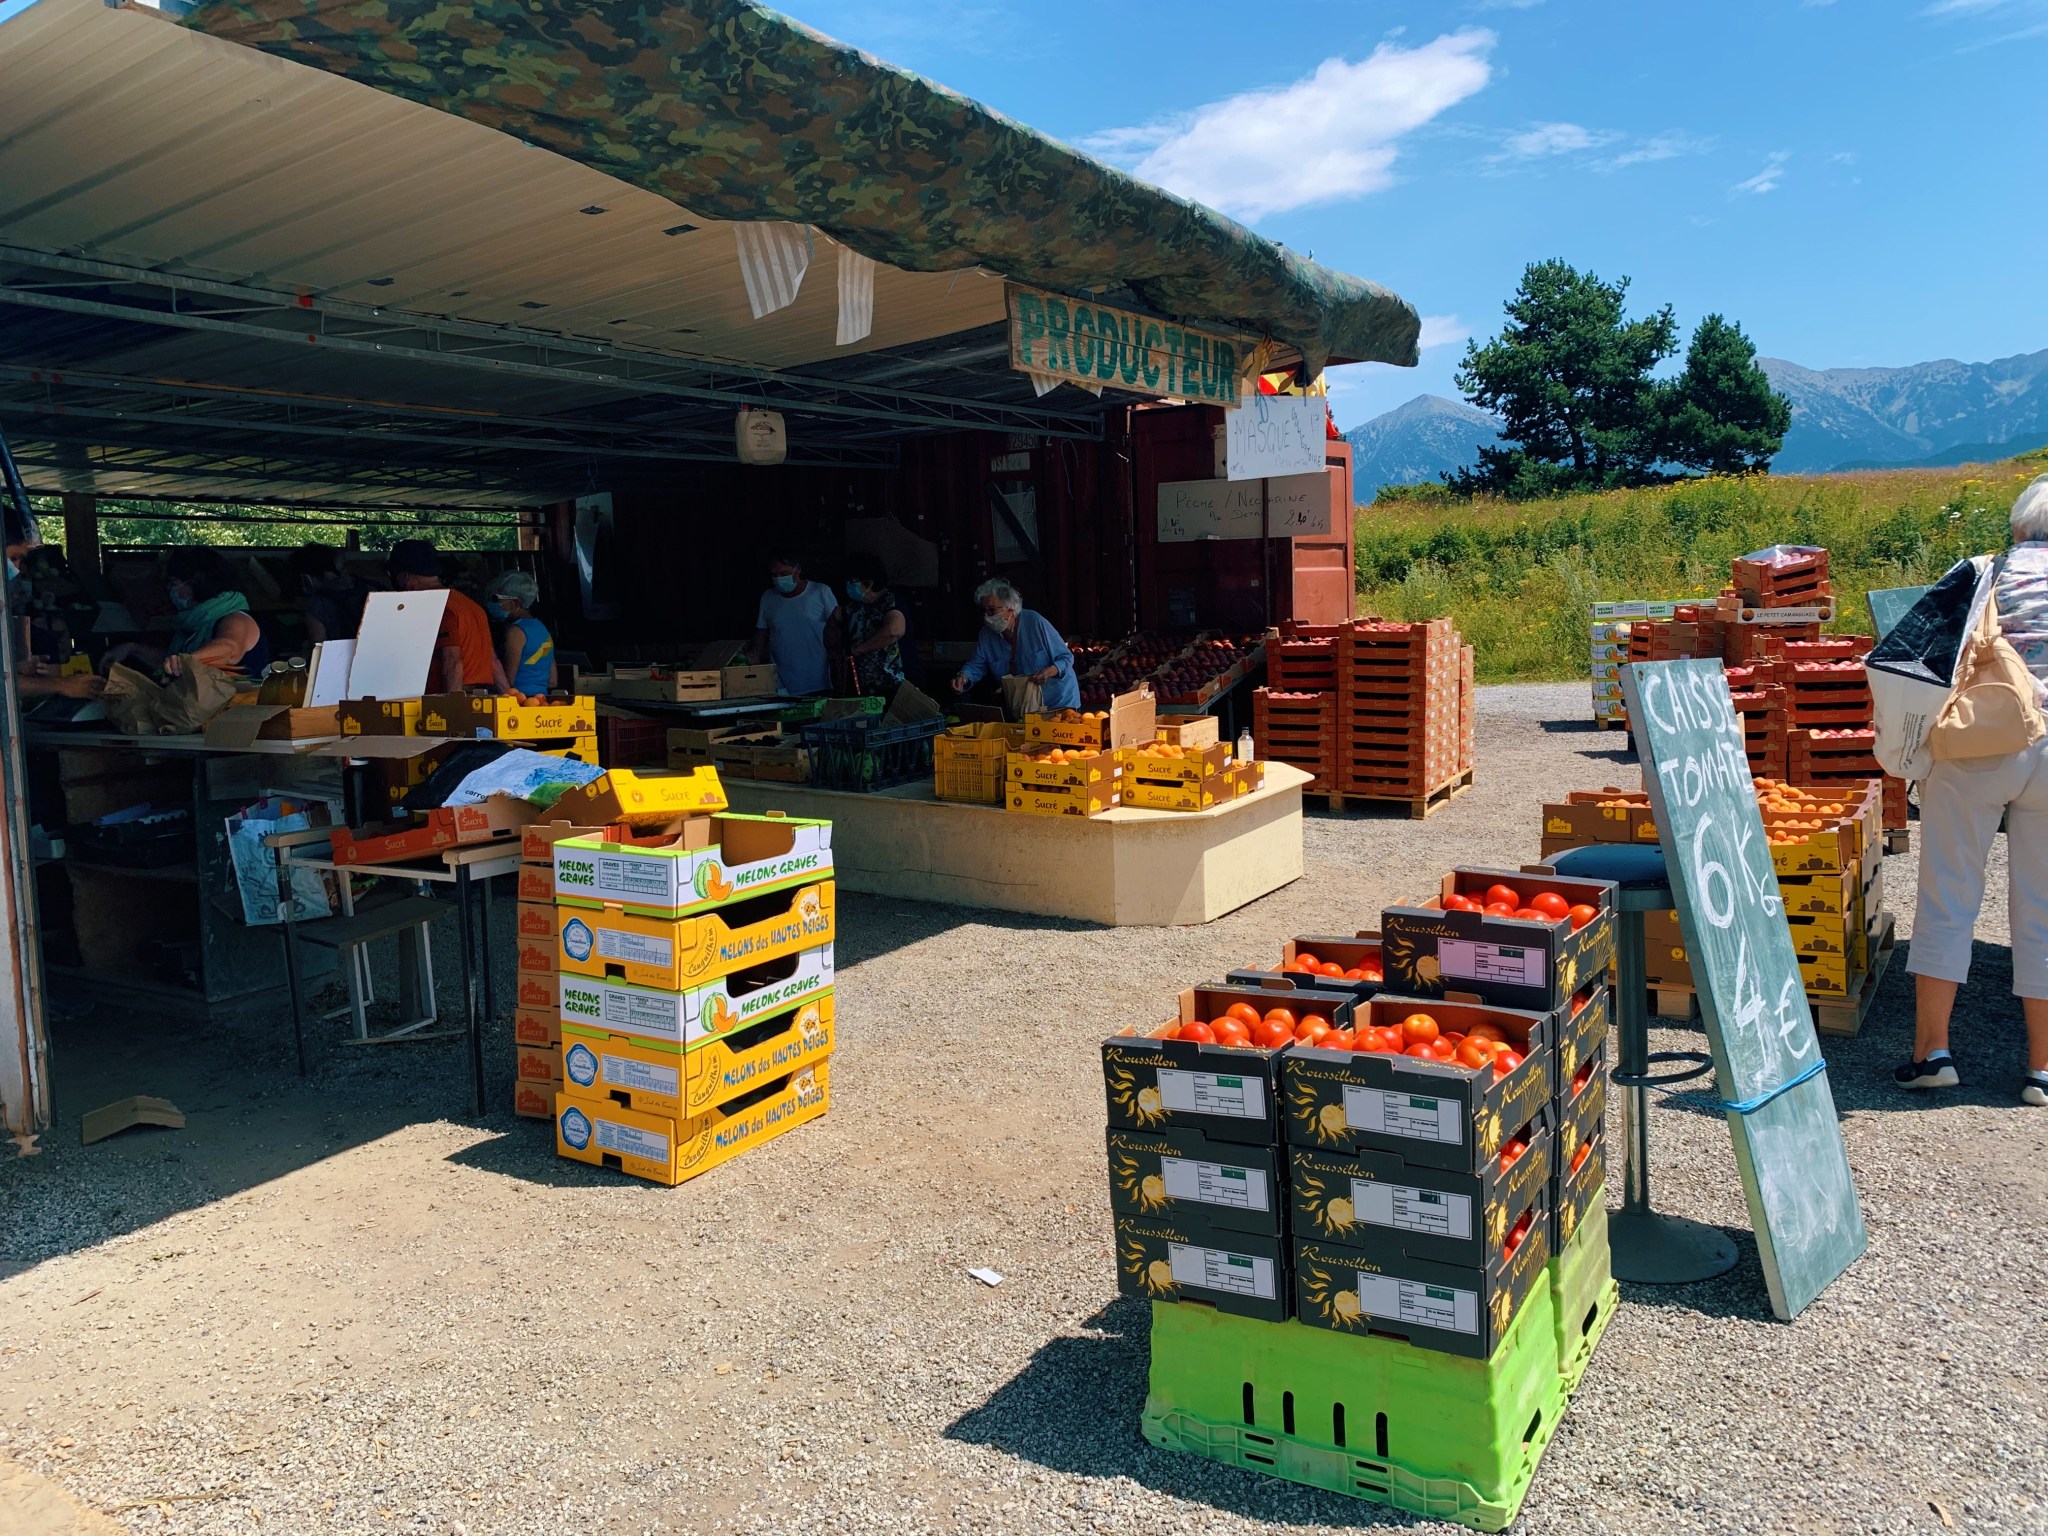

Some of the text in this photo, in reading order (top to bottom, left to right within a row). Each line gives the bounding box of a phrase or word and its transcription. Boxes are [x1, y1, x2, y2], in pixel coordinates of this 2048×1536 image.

[1018, 292, 1235, 403] PRODUCTEUR
[1235, 416, 1290, 456] MASQUE
[1238, 490, 1307, 508] NECARINE
[534, 713, 563, 729] Sucré
[1052, 728, 1074, 740] Sucré
[1035, 768, 1058, 781] Sucré
[1147, 763, 1172, 774] Sucré
[660, 787, 691, 803] Sucré
[1035, 798, 1058, 810] Sucré
[1147, 791, 1171, 803] Sucré
[462, 814, 483, 827] Sucré
[558, 859, 595, 873] MELONS
[736, 854, 818, 887] MELONS GRAVES
[559, 872, 595, 886] GRAVES
[1387, 916, 1460, 938] Roussillon
[719, 936, 754, 963] MELONS
[755, 933, 769, 952] des
[770, 921, 801, 945] HAUTES
[564, 988, 601, 1005] MELONS
[741, 974, 820, 1017] MELONS GRAVES
[564, 1000, 601, 1017] GRAVES
[723, 1060, 756, 1090] MELONS
[758, 1057, 770, 1074] des
[772, 1040, 802, 1066] HAUTES
[1106, 1047, 1178, 1068] Roussillon
[1285, 1059, 1366, 1085] Roussillon
[715, 1119, 750, 1151] MELONS
[751, 1115, 764, 1133] des
[765, 1097, 796, 1127] HAUTES
[1110, 1133, 1182, 1157] Roussillon
[1293, 1152, 1375, 1179] Roussillon
[1118, 1218, 1190, 1243] Roussillon
[1300, 1245, 1382, 1273] Roussillon
